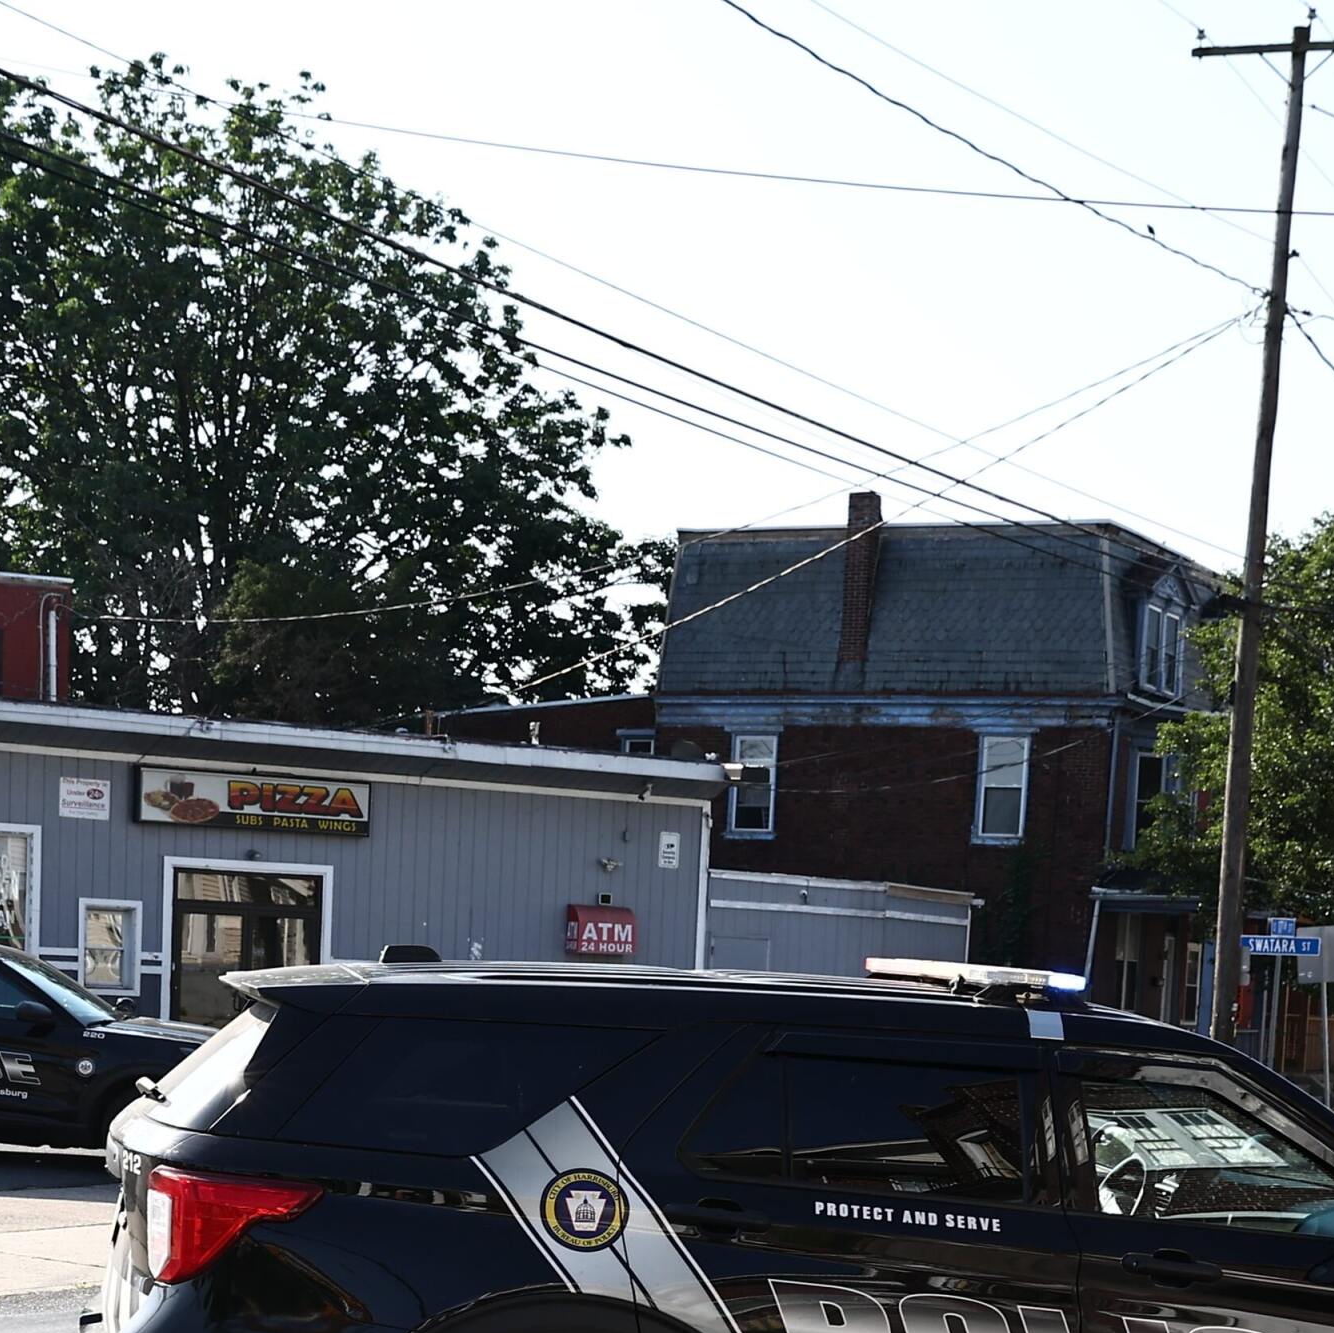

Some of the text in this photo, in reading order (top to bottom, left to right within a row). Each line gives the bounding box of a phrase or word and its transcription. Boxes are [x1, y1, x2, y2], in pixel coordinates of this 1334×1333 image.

[227, 780, 364, 819] PIZZA
[235, 814, 356, 832] SUBS PASTA WINGS
[581, 922, 633, 942] ATM
[581, 941, 595, 951] 24
[598, 943, 633, 953] HOUR
[1248, 938, 1312, 953] SWATARA ST
[82, 1031, 106, 1039] 220
[122, 1149, 142, 1176] 212
[548, 1184, 563, 1200] CITY
[814, 1200, 1002, 1233] PROTECT AND SERVE
[552, 1224, 581, 1246] BUREAU
[594, 1224, 619, 1245] POLICE
